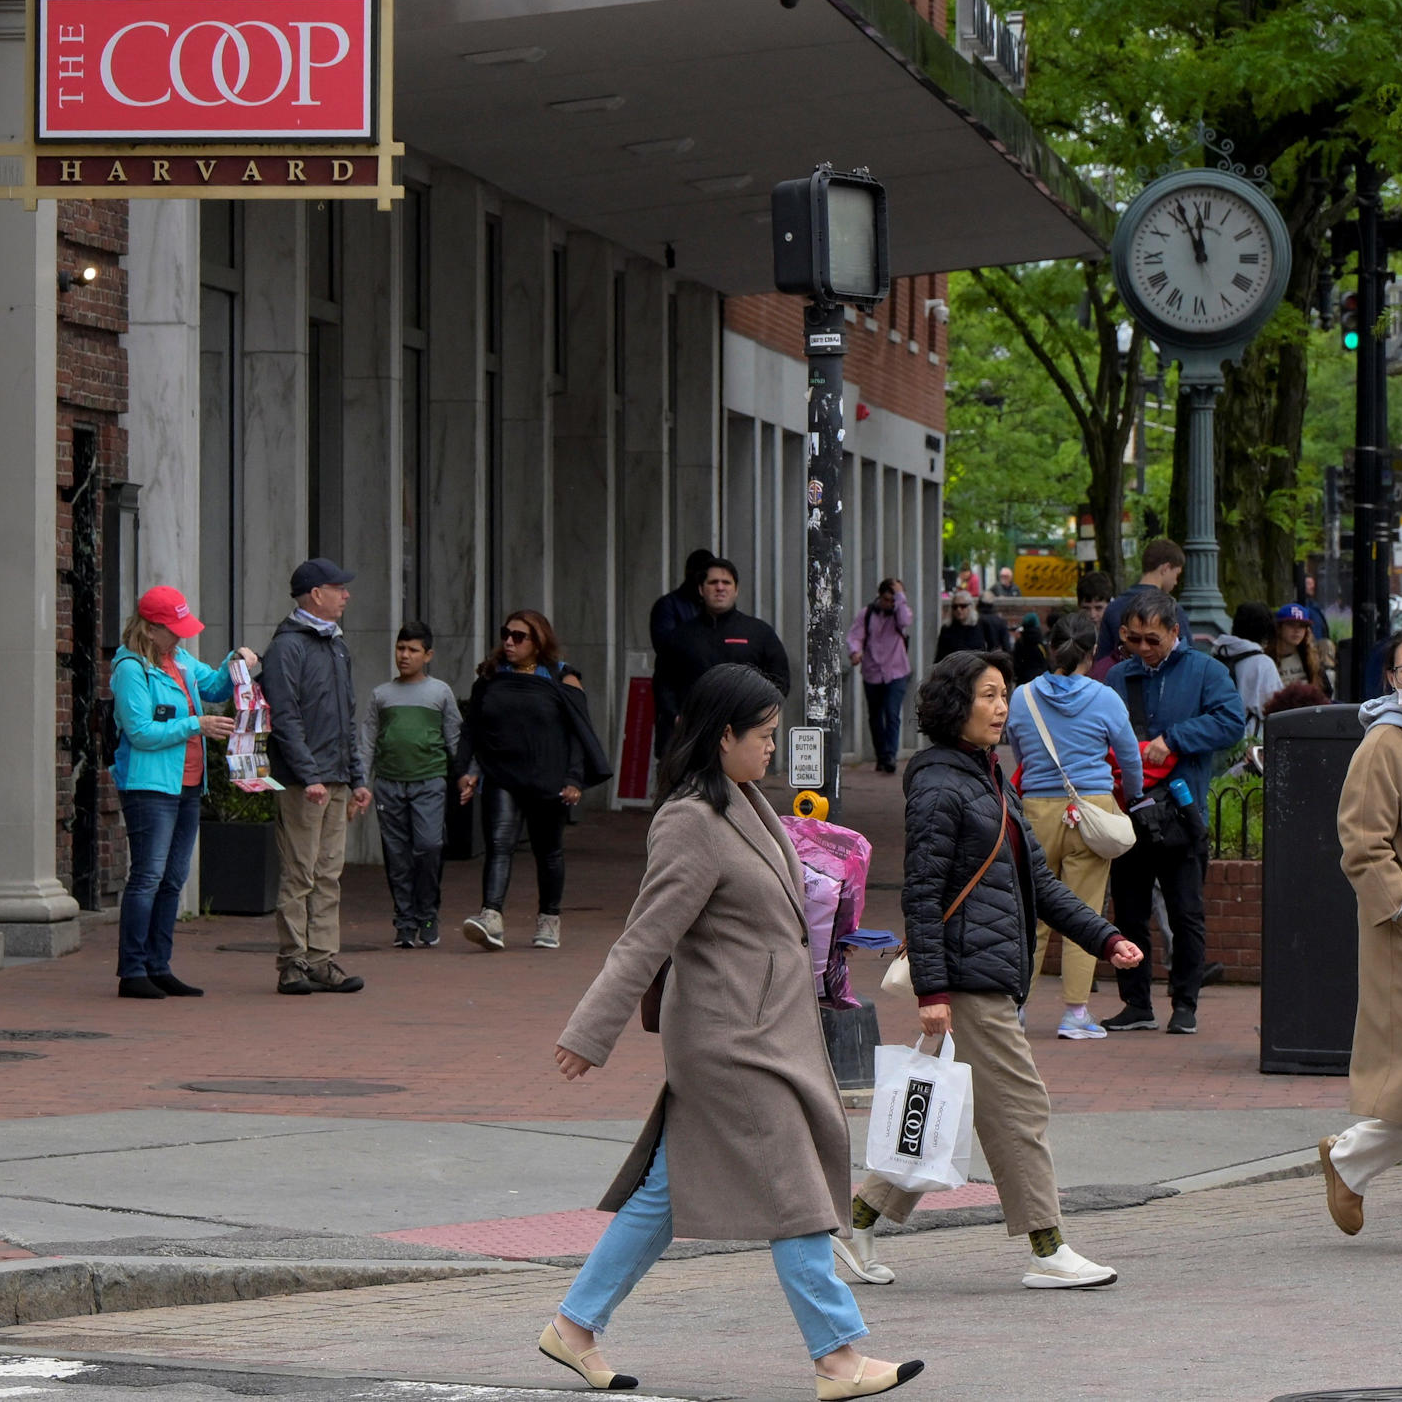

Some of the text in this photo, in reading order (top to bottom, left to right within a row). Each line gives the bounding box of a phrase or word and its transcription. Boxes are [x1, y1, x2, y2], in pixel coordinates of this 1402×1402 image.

[59, 23, 85, 109] THE
[100, 20, 350, 107] COOP
[60, 159, 354, 182] HARVARD
[799, 734, 814, 742] PUSH
[912, 1083, 930, 1093] THE
[902, 1094, 926, 1152] COOP
